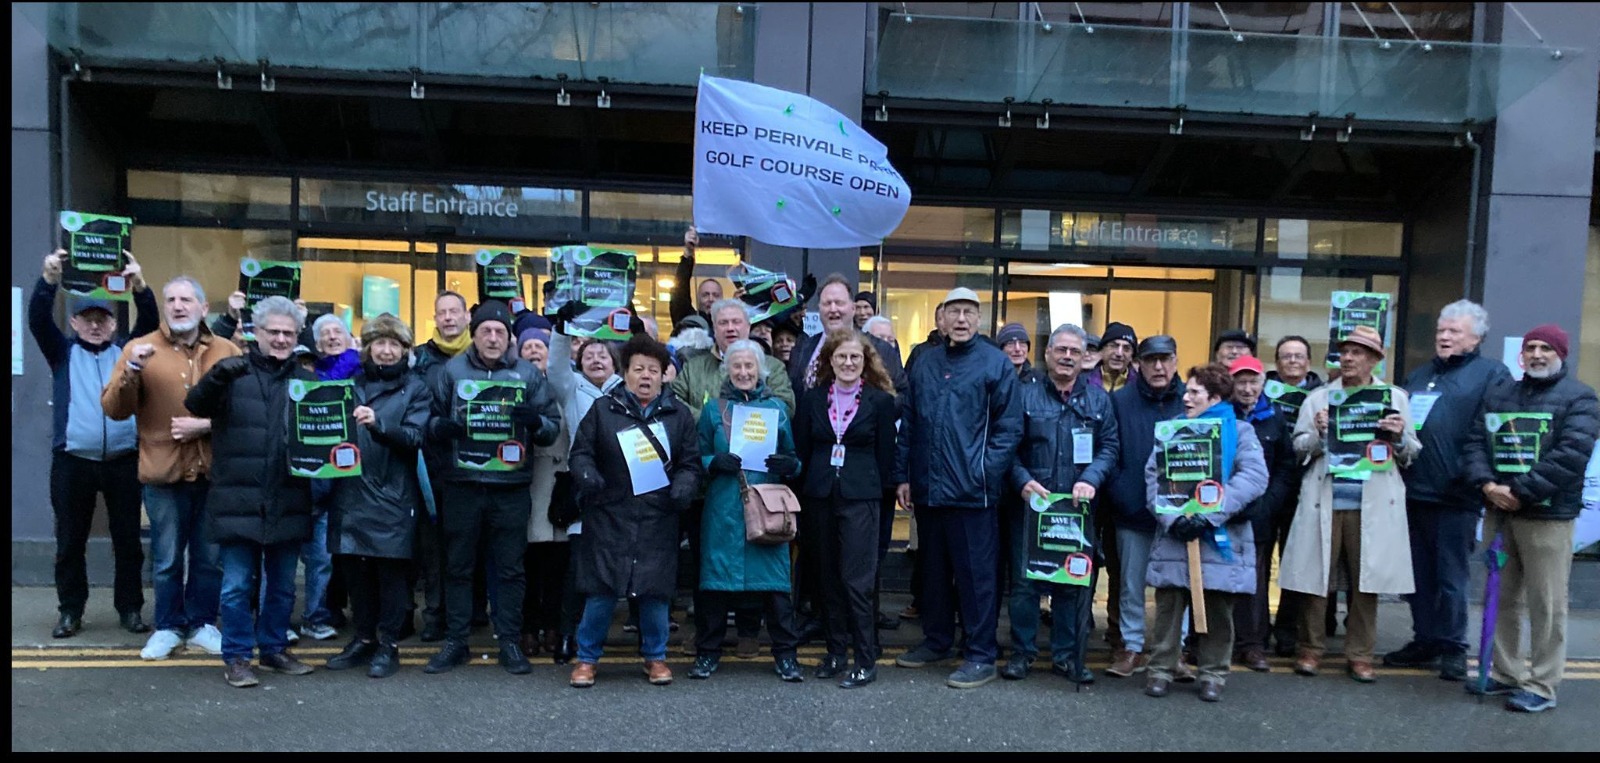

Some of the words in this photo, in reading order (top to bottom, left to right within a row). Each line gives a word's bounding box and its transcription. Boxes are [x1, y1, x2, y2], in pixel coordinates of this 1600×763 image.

[701, 120, 748, 137] KEEP
[754, 127, 853, 160] PERIVALE
[706, 150, 755, 168] GOLF
[760, 158, 844, 186] COURSE
[849, 176, 900, 199] OPEN
[365, 190, 417, 213] Staff
[422, 193, 519, 218] Entrance
[1111, 220, 1199, 244] Entrance
[309, 406, 329, 414] SAVE
[481, 405, 500, 413] SAVE
[1177, 443, 1196, 451] SAVE
[1051, 516, 1069, 524] SAVE
